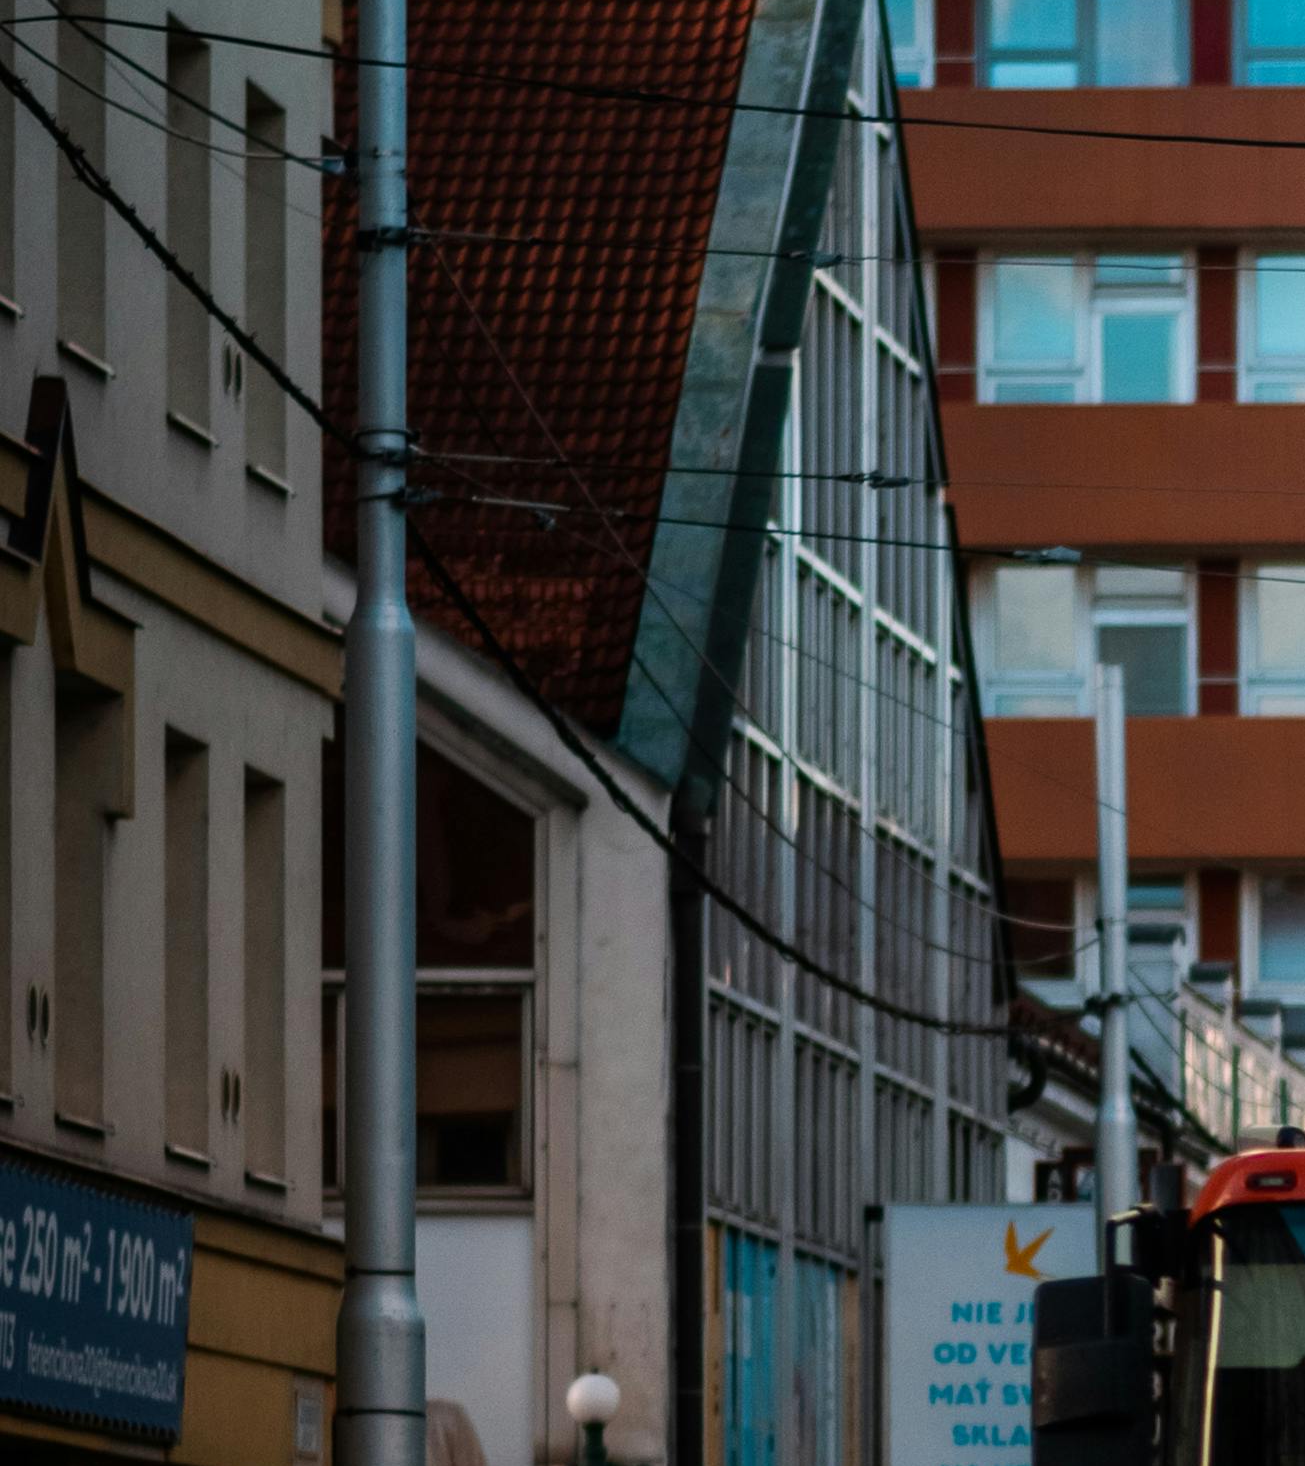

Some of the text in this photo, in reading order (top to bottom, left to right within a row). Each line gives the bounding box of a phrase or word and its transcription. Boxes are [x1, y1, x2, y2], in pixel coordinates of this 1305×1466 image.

[20, 1205, 58, 1299] 250
[61, 1220, 92, 1303] m²
[157, 1249, 186, 1327] m²
[952, 1302, 1001, 1324] NIE
[934, 1343, 1034, 1365] OD VE
